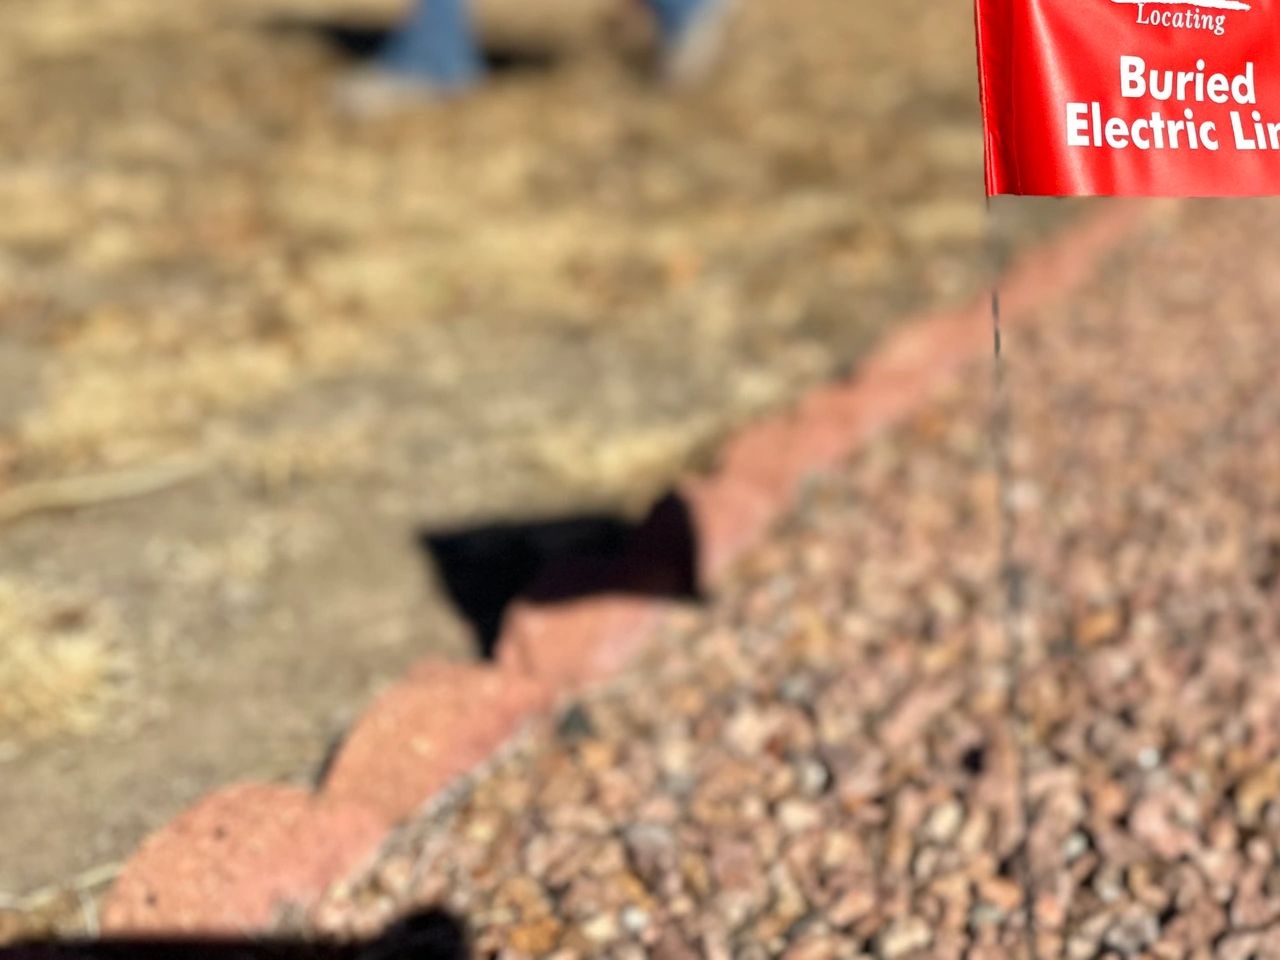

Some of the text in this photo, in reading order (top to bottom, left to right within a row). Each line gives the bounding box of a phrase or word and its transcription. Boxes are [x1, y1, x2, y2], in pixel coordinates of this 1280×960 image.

[1136, 3, 1226, 36] Locating
[1119, 54, 1256, 105] Buried
[1065, 101, 1219, 151] Electric
